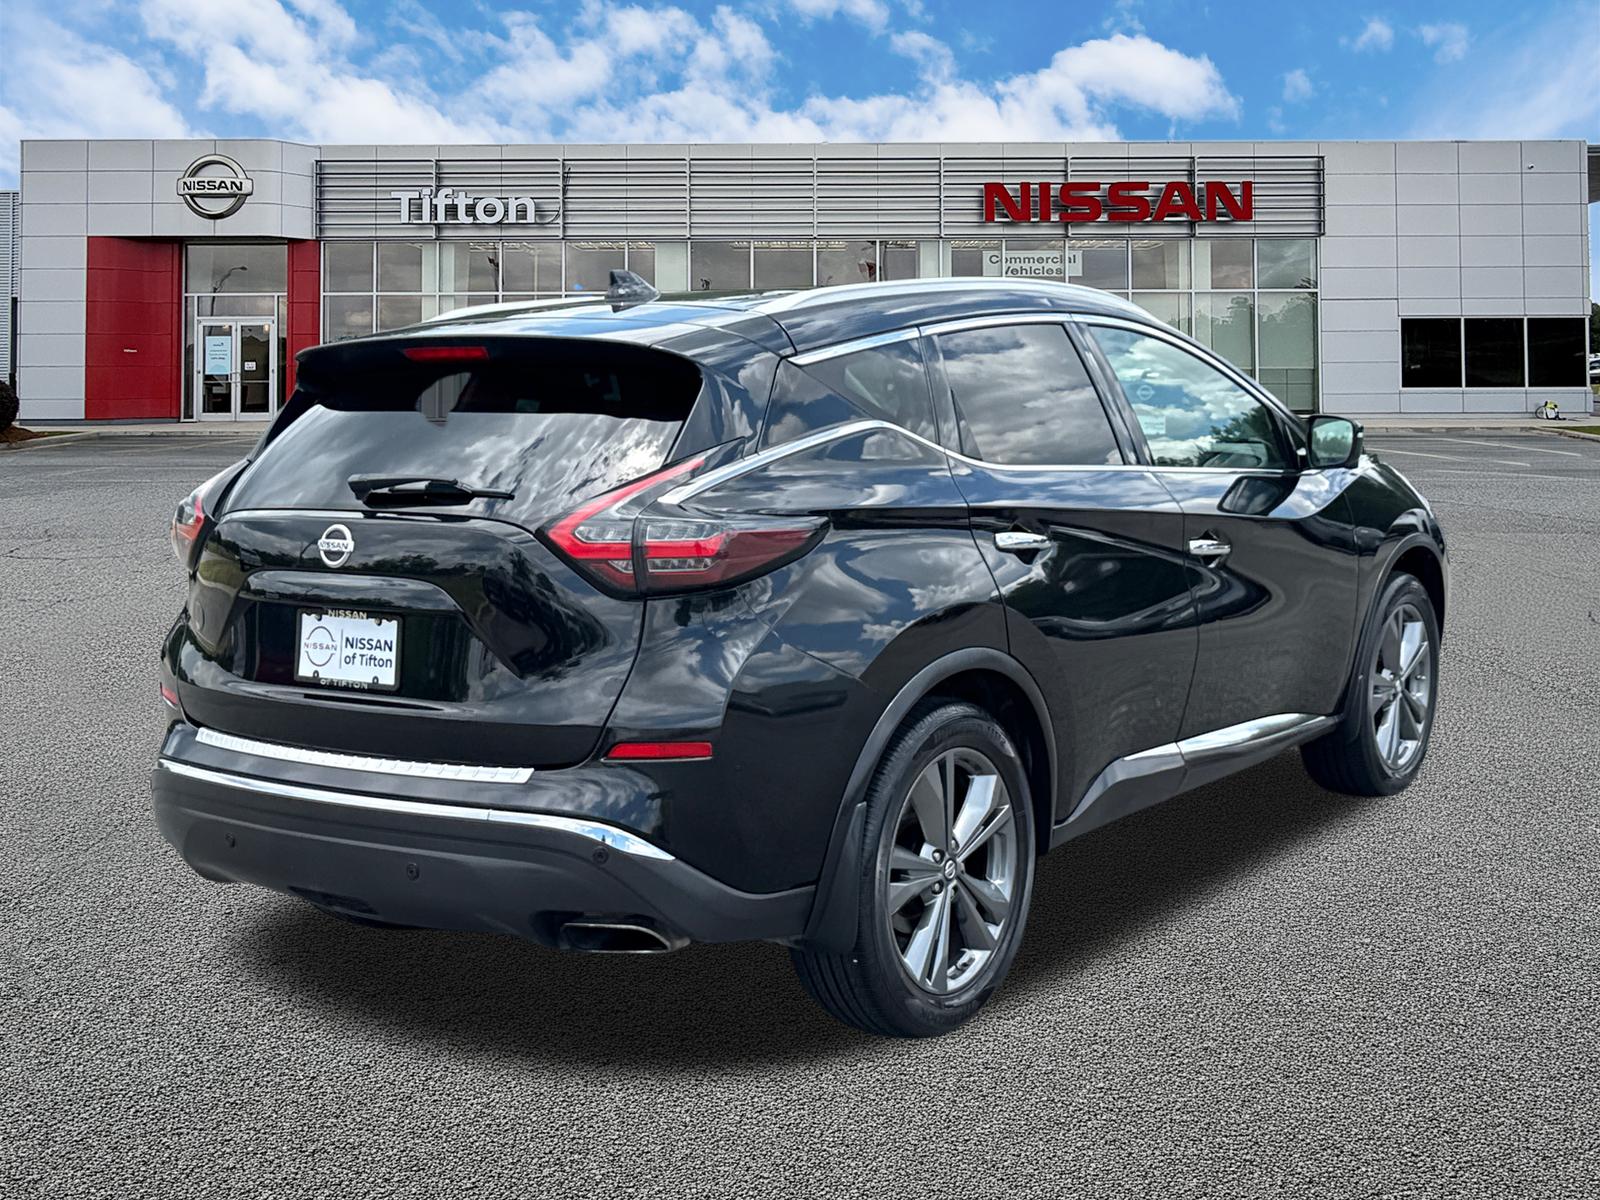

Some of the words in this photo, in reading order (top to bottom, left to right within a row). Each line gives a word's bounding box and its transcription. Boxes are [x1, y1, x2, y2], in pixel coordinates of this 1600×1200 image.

[182, 180, 243, 191] NISSAN
[391, 187, 536, 224] Tifton
[983, 181, 1253, 223] NISSAN
[320, 541, 349, 550] NISSAN
[328, 609, 368, 620] NISSAN
[304, 642, 338, 651] NISSAN
[345, 637, 393, 652] NISSAN
[344, 652, 357, 665] of
[359, 653, 393, 668] Tifton
[333, 679, 368, 689] TIFTON
